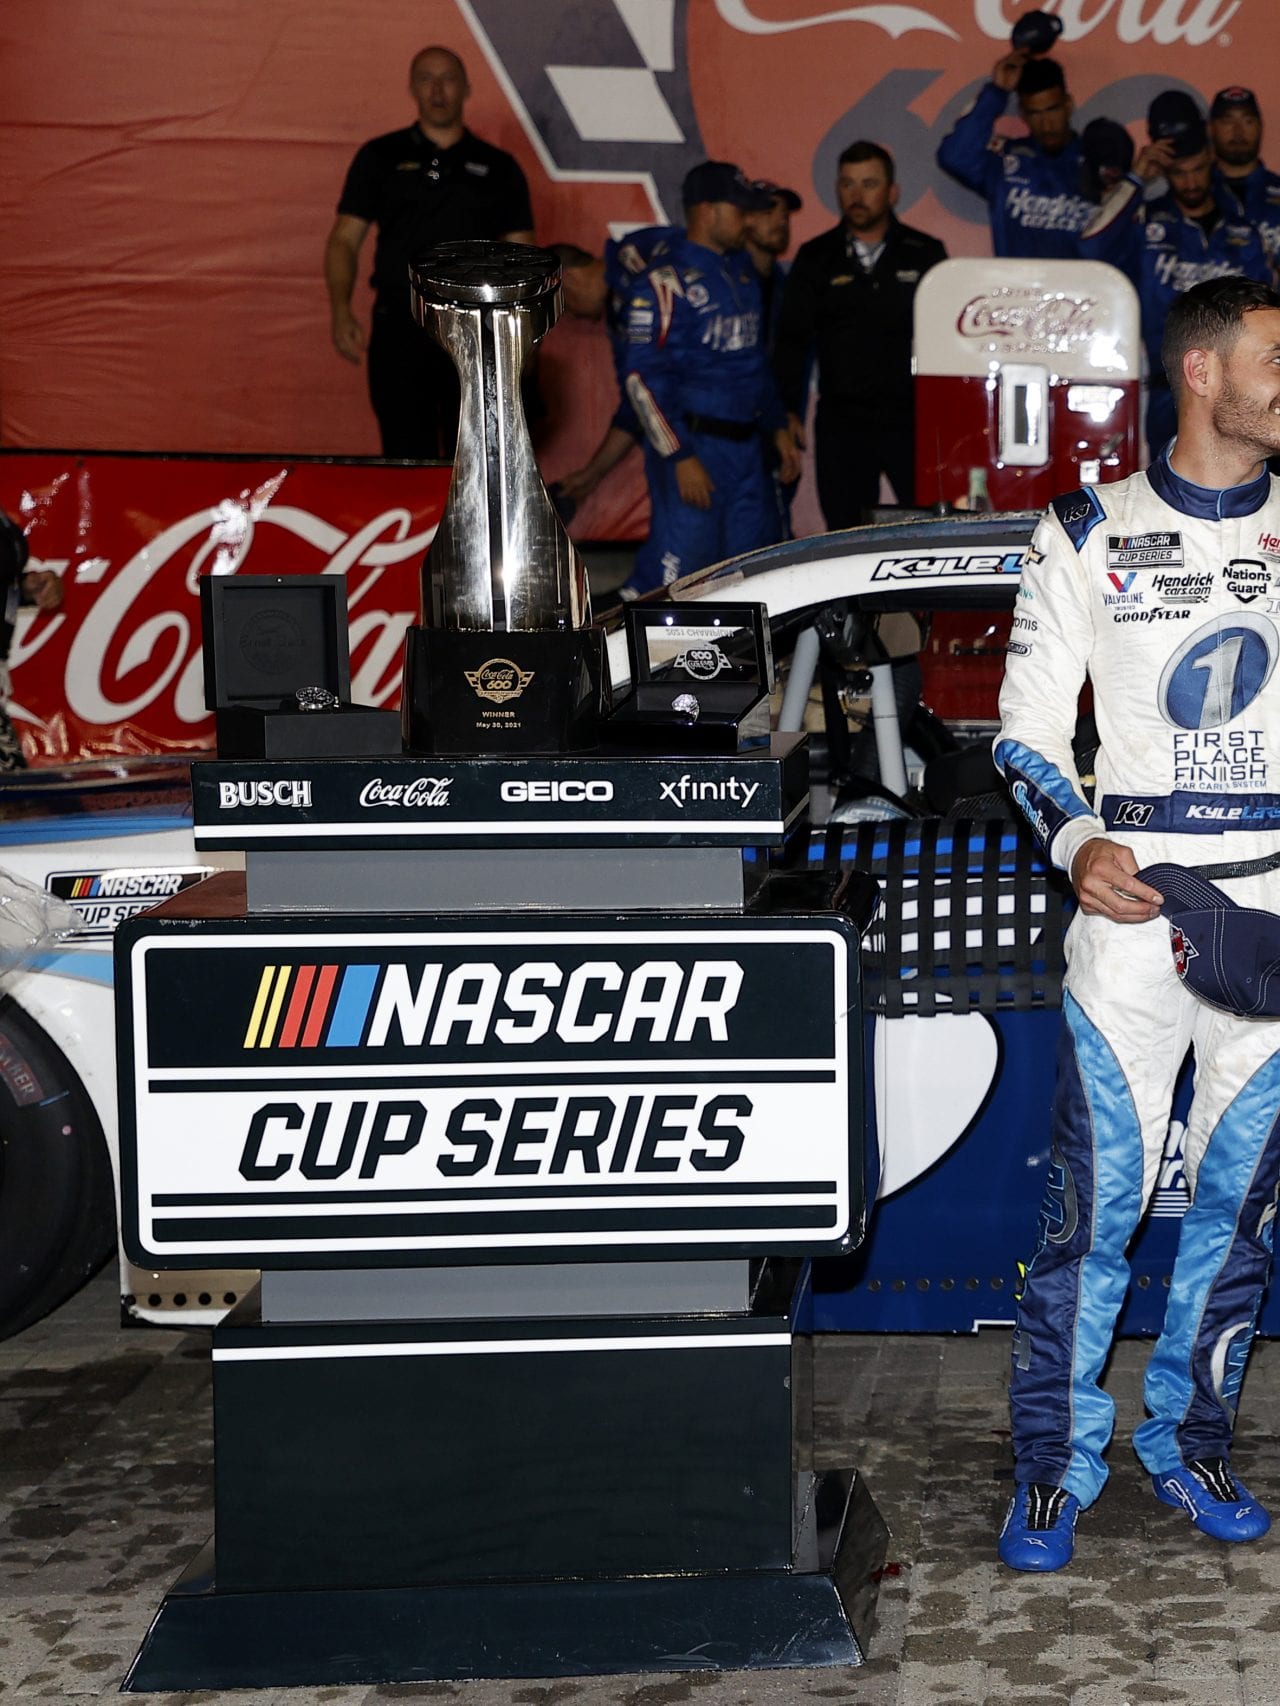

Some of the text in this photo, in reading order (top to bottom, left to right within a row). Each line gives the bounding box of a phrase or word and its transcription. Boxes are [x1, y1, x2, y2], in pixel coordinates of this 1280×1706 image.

[1131, 535, 1171, 547] NASCAR
[1118, 550, 1172, 562] CUP SERIES
[1151, 572, 1215, 592] Hendrick
[1222, 567, 1272, 582] Nations
[1165, 586, 1211, 596] cars.com
[1226, 582, 1268, 595] Guard
[1102, 591, 1144, 607] VALVOLINE
[1114, 606, 1191, 624] GOODYEAR
[481, 668, 515, 680] Coca-Cola
[486, 680, 513, 690] 600
[476, 722, 491, 730] May
[1173, 730, 1264, 749] FIRST
[1174, 747, 1266, 766] PLACE
[1174, 764, 1267, 782] FINISH
[219, 775, 760, 809] BUSCH Coca-Cola GEICO xfinity
[1113, 800, 1155, 826] K1
[98, 875, 184, 897] NASCAR
[366, 961, 746, 1047] NASCAR
[238, 1093, 754, 1182] CUP SERIES
